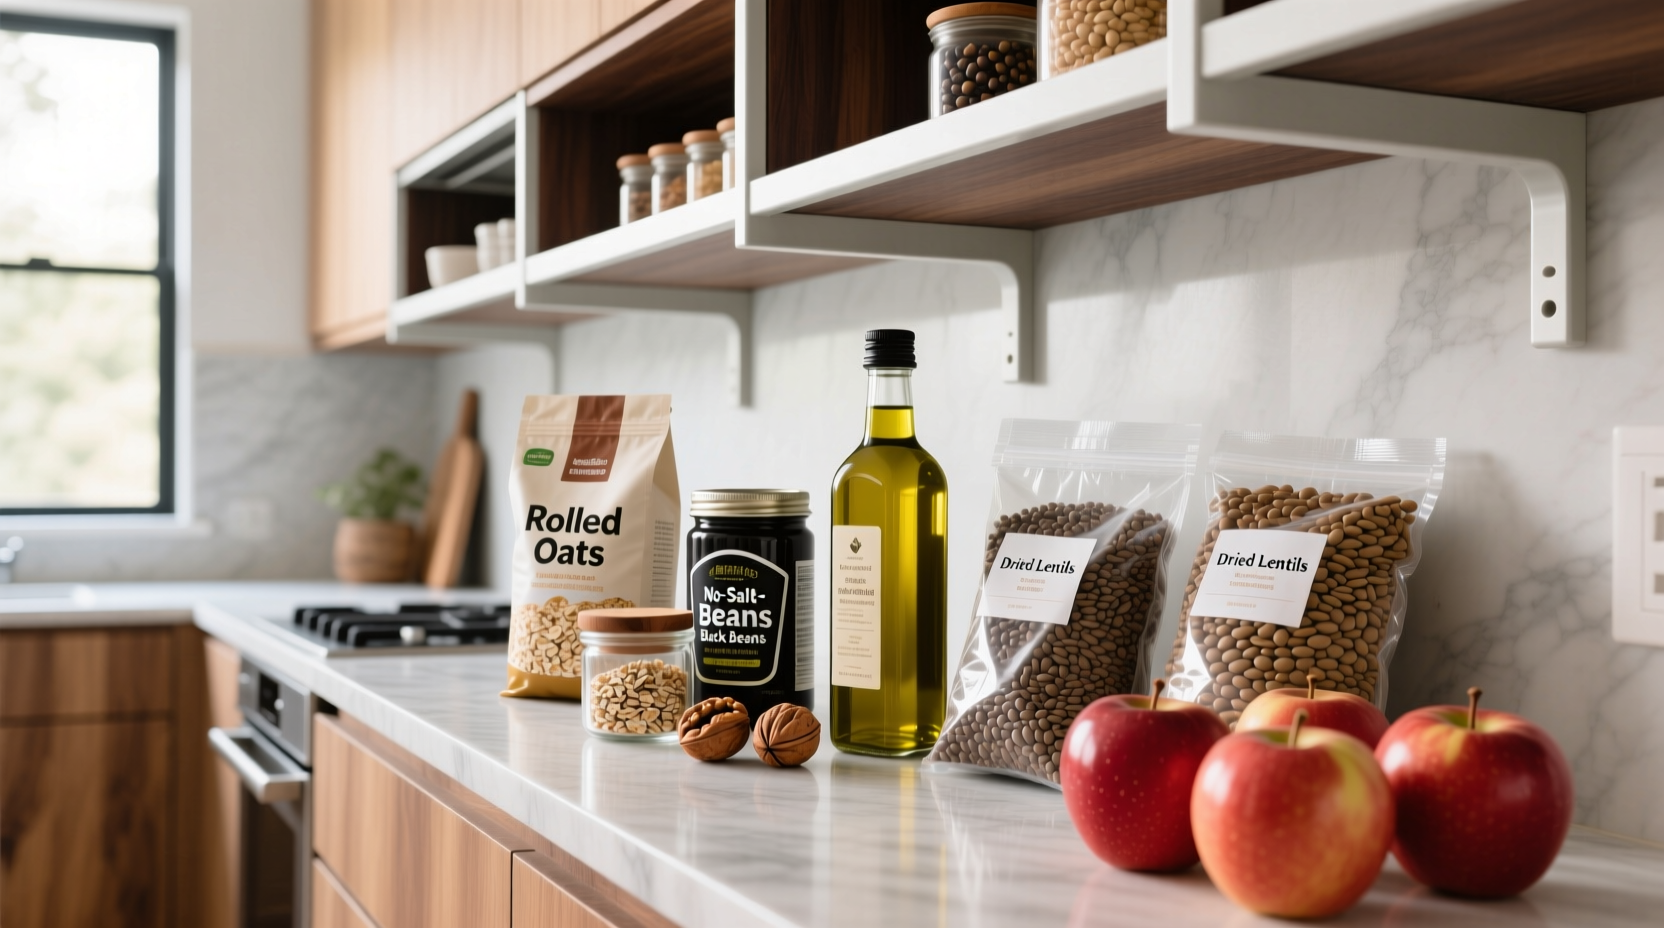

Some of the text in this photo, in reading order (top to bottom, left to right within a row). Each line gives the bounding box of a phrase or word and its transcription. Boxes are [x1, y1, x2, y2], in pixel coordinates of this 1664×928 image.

[525, 504, 623, 536] Rolled
[533, 536, 605, 567] Oats
[1216, 552, 1309, 573] Dried Lentils
[699, 602, 773, 629] Beans
[729, 630, 767, 645] Beans
